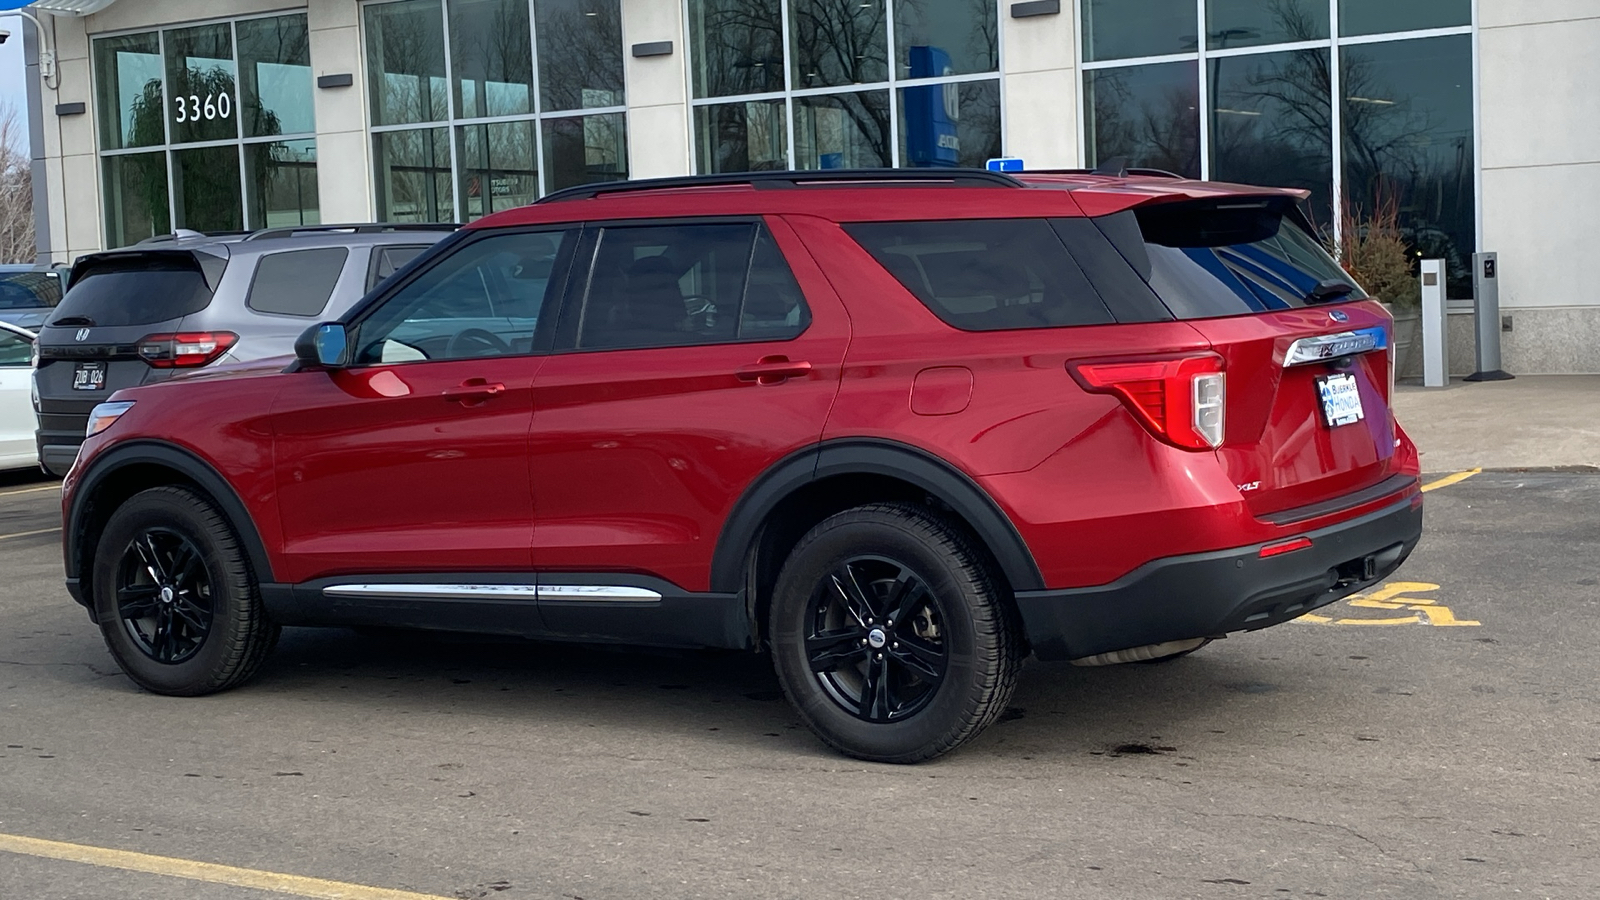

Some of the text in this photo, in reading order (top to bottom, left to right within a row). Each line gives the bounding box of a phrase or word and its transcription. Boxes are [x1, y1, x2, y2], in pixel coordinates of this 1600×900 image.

[175, 92, 231, 123] 3360
[1333, 395, 1360, 412] HONDA
[1236, 480, 1262, 491] XLT
